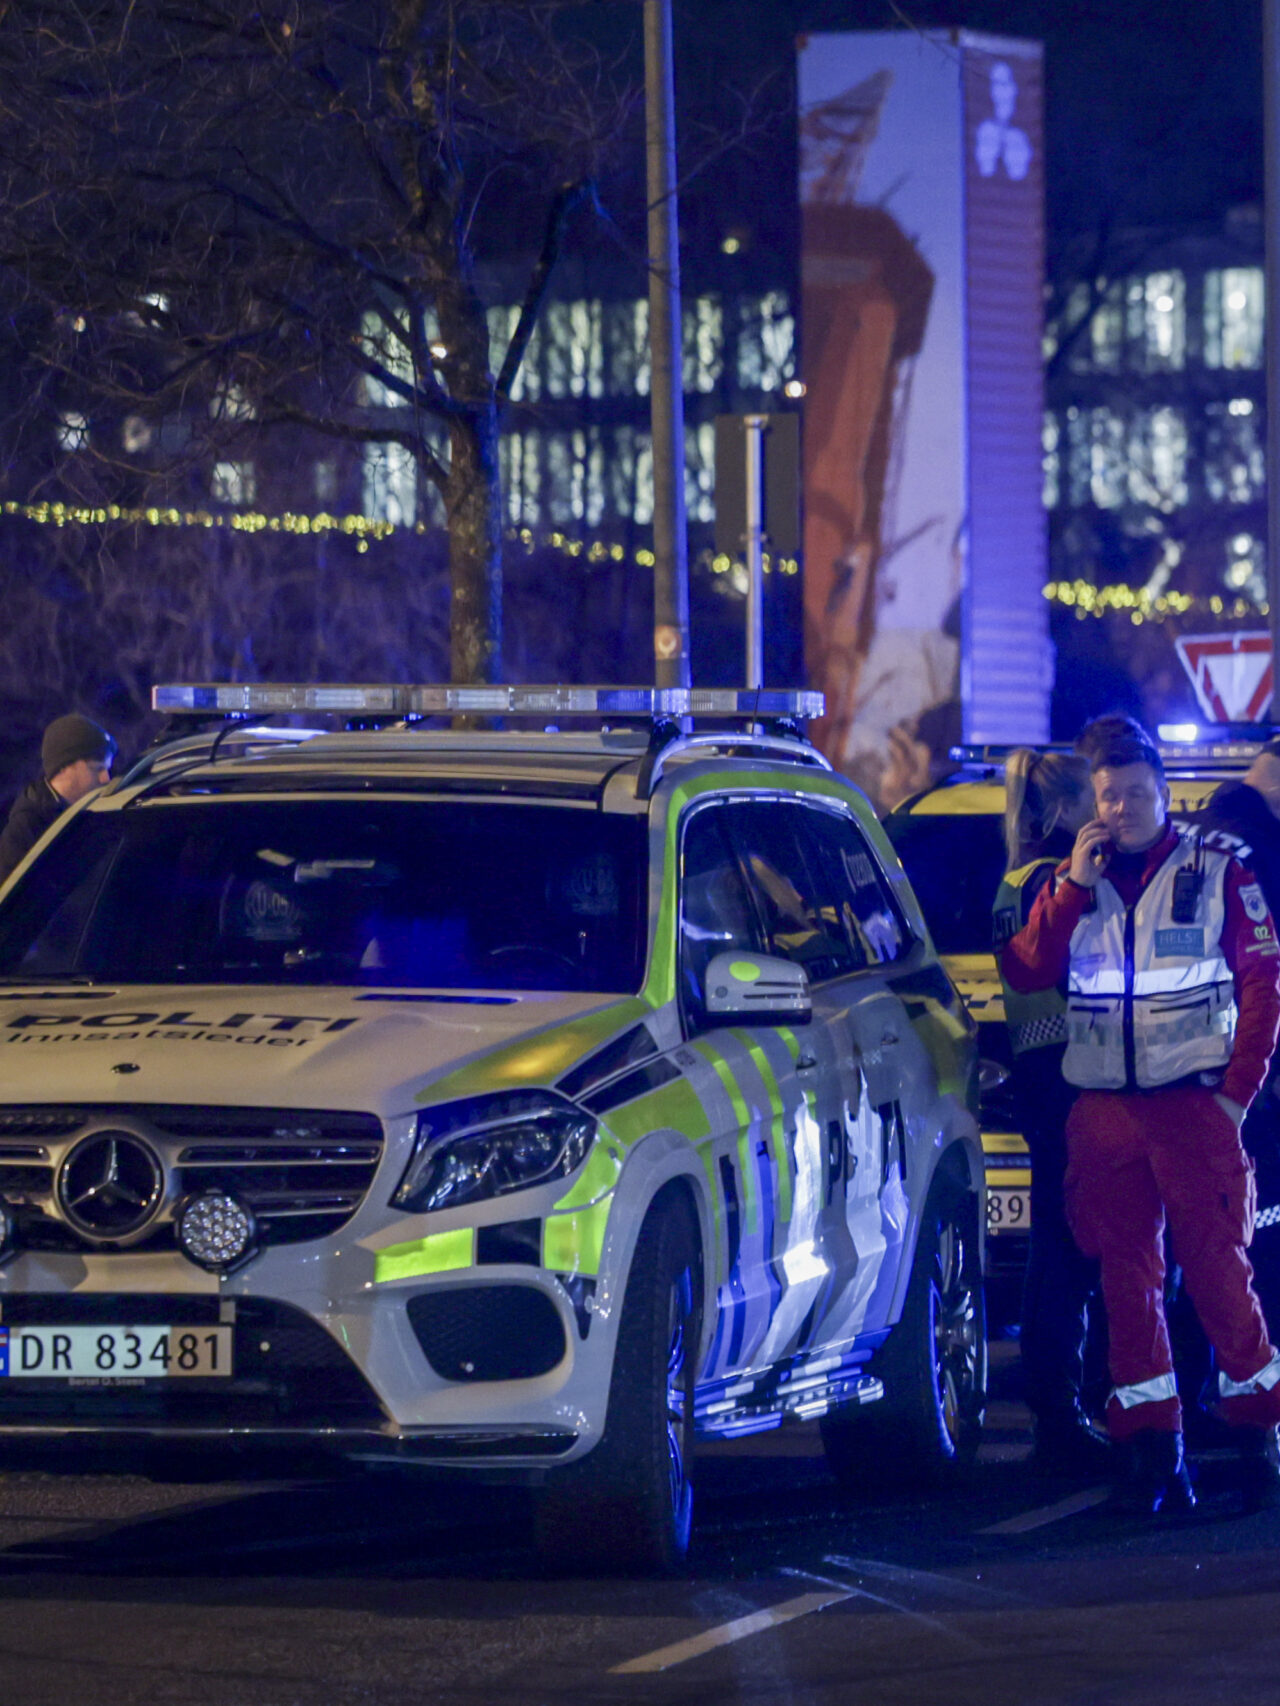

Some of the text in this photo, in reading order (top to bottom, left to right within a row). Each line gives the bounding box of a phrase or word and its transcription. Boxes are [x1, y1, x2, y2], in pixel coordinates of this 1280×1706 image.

[6, 1011, 360, 1032] POLITI
[6, 1030, 315, 1047] Innsatsleder
[21, 1334, 218, 1370] DR 83481
